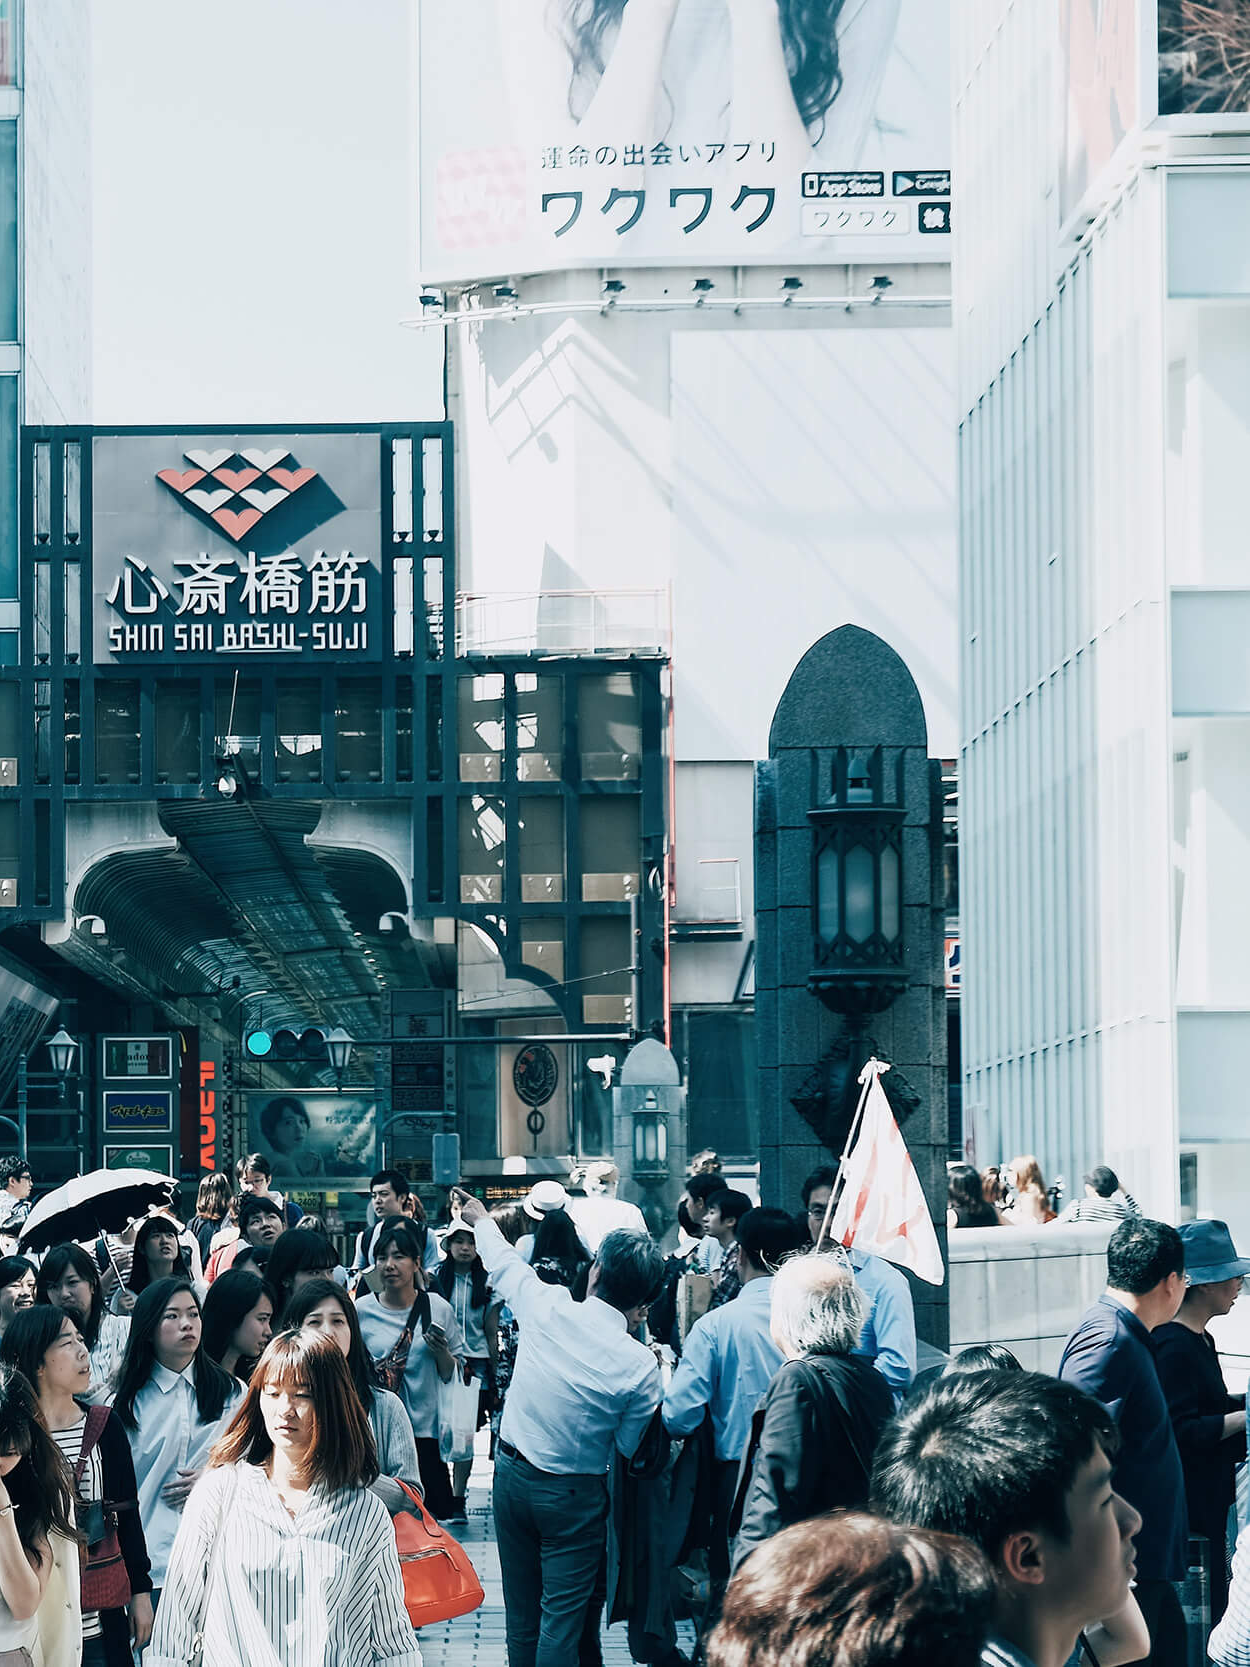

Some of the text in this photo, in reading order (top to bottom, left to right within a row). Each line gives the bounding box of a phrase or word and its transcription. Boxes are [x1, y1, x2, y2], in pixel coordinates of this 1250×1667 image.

[542, 141, 776, 169] 運命の出会いアプリ
[820, 181, 882, 197] App Store
[541, 184, 776, 238] ワクワク
[813, 210, 897, 229] ワクワク
[106, 551, 371, 616] 心斎橋筋
[109, 623, 163, 652] SHIN
[174, 623, 213, 651] SAI
